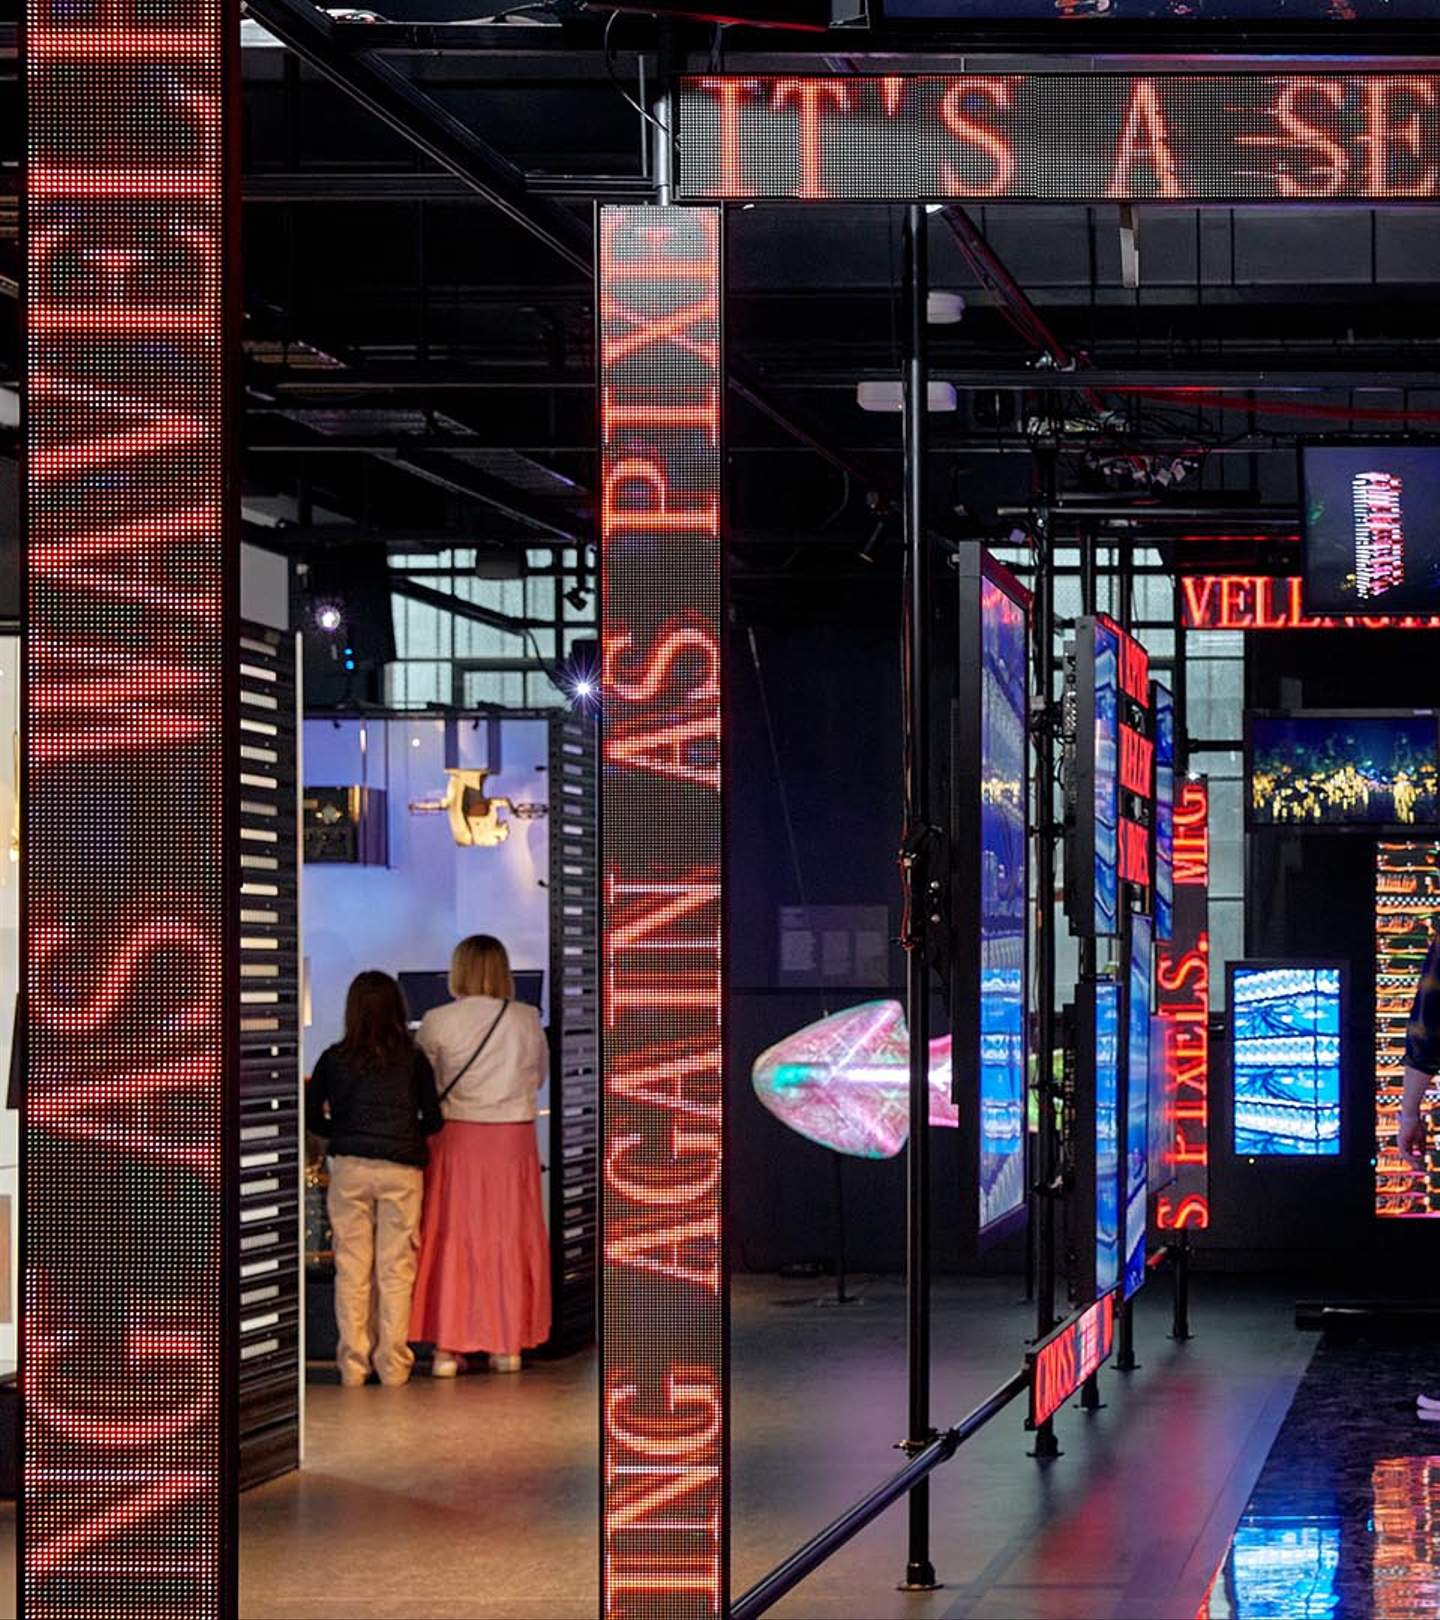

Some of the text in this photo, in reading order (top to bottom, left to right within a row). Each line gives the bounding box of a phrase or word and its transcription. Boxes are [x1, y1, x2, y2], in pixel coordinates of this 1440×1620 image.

[700, 75, 1018, 198] IT'S
[1105, 77, 1190, 198] A
[602, 626, 719, 792] AS
[30, 918, 221, 1184] AS
[603, 865, 720, 1296] AGAIN
[605, 1372, 720, 1614] ING
